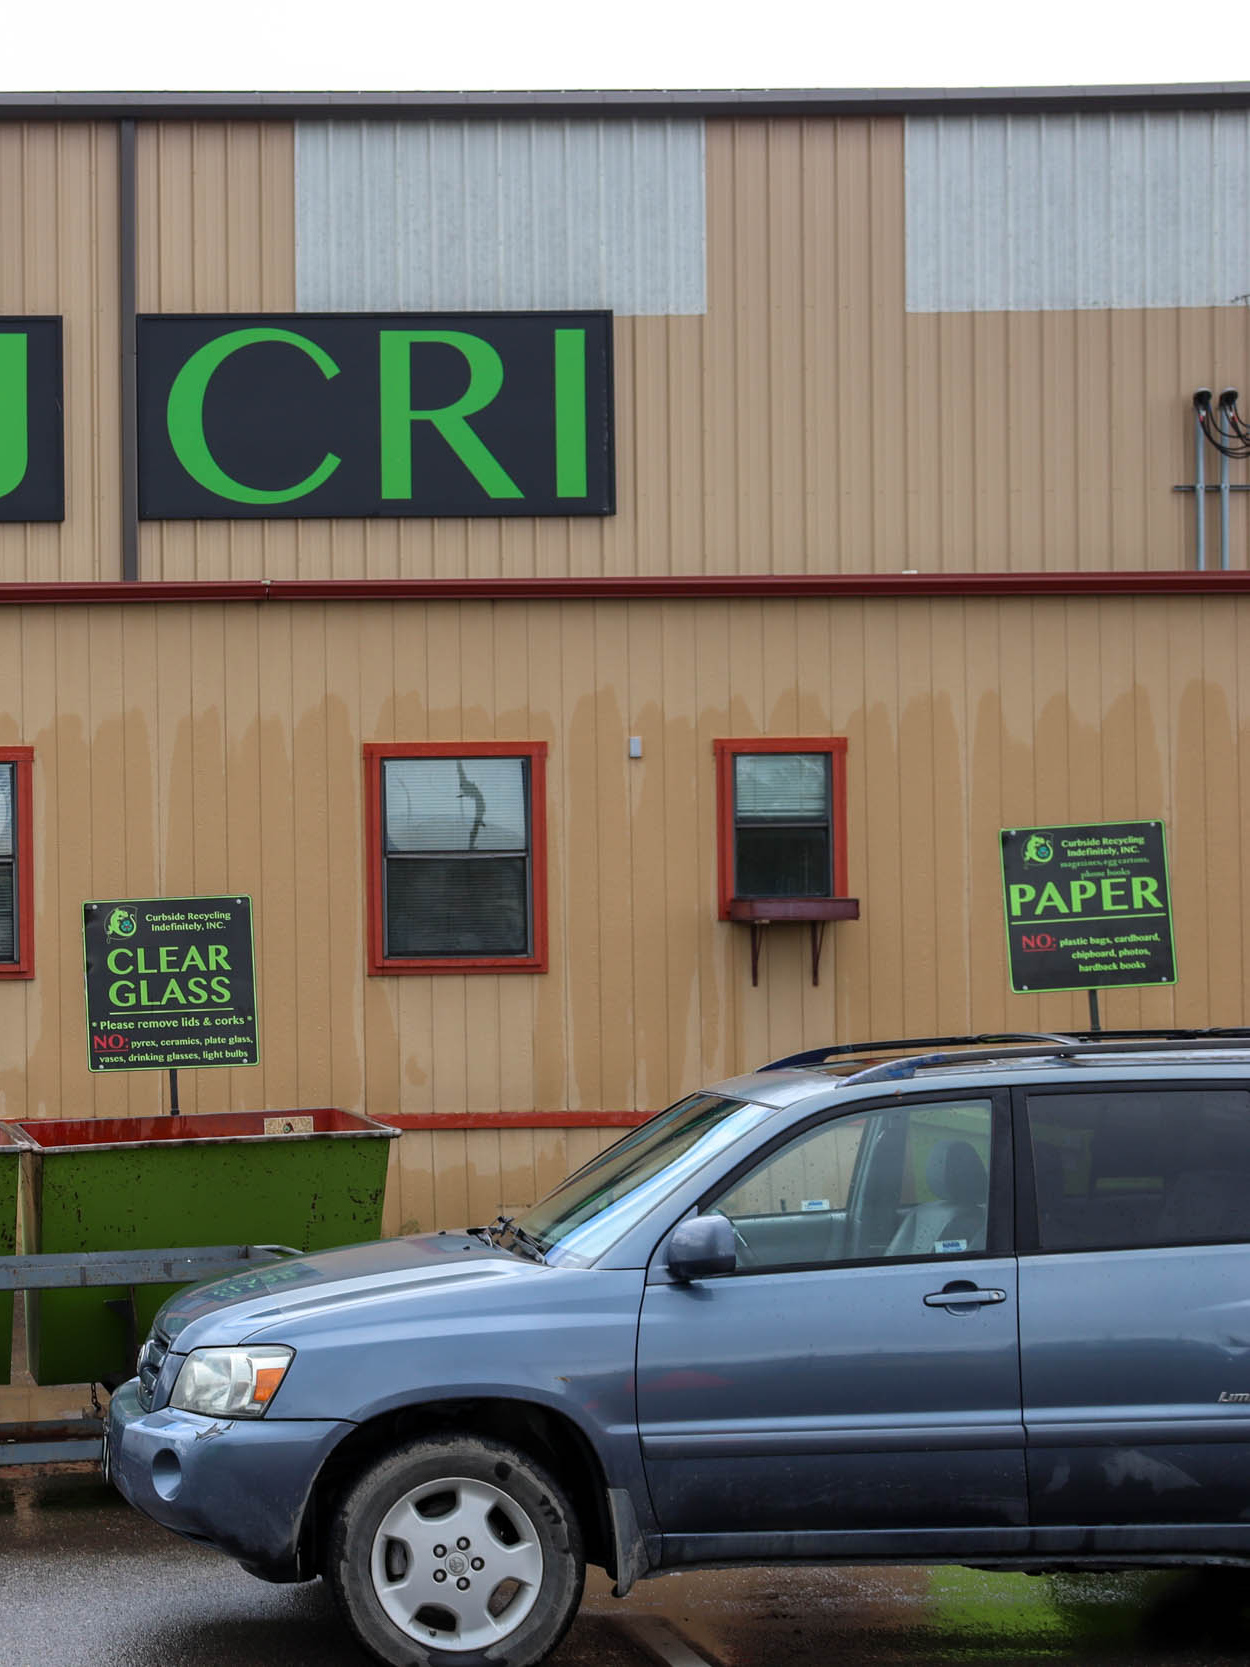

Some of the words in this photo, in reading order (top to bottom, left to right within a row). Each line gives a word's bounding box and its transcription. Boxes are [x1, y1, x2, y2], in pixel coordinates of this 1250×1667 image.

[166, 327, 587, 504] CRI
[1061, 838, 1100, 848] Curbside
[1102, 836, 1145, 846] Recycling
[1009, 876, 1164, 916] PAPER
[145, 912, 185, 922] Curbside
[187, 911, 231, 921] Recycling
[151, 922, 205, 932] Indefinitely,
[206, 921, 226, 930] INC.
[1059, 937, 1088, 948] plastic
[1114, 933, 1160, 943] cardboard,
[107, 944, 232, 975] CLEAR
[1118, 948, 1150, 958] photos,
[1078, 962, 1118, 972] hardback
[1120, 961, 1146, 970] books
[108, 976, 231, 1007] GLASS
[100, 1019, 135, 1030] Please
[138, 1020, 178, 1029] remove
[181, 1017, 200, 1026] lids
[203, 1017, 212, 1026] &
[215, 1015, 245, 1025] corks
[94, 1033, 129, 1050] NO:
[131, 1038, 158, 1048] pyrex,
[160, 1036, 202, 1046] ceramics,
[204, 1035, 226, 1046] plate
[228, 1034, 253, 1045] glass,
[100, 1055, 126, 1063] vases,
[128, 1052, 164, 1063] drinking
[166, 1052, 201, 1062] glasses,
[203, 1050, 223, 1060] light
[225, 1049, 248, 1058] bulbs
